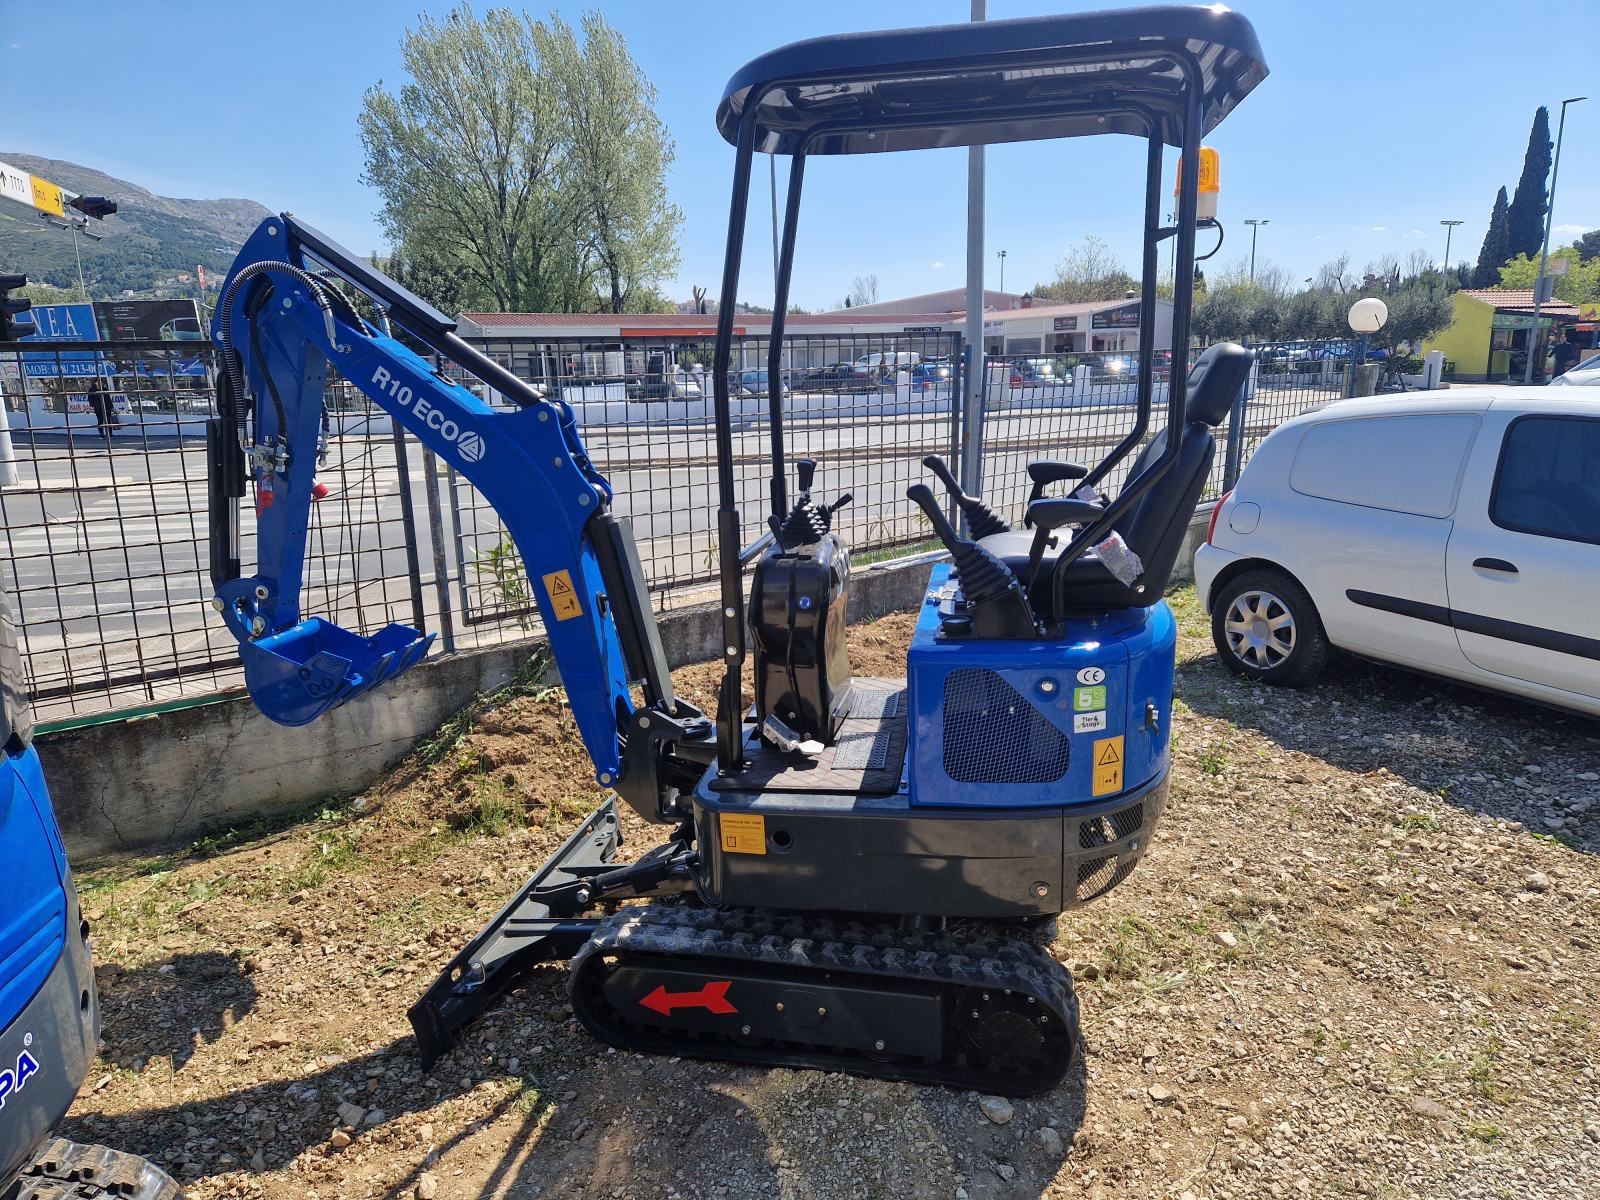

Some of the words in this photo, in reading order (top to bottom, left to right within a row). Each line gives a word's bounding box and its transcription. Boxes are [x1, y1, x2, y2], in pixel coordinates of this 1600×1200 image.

[26, 364, 50, 375] MOB:
[371, 365, 413, 406] R10
[412, 397, 459, 441] ECO
[1079, 688, 1093, 708] 5
